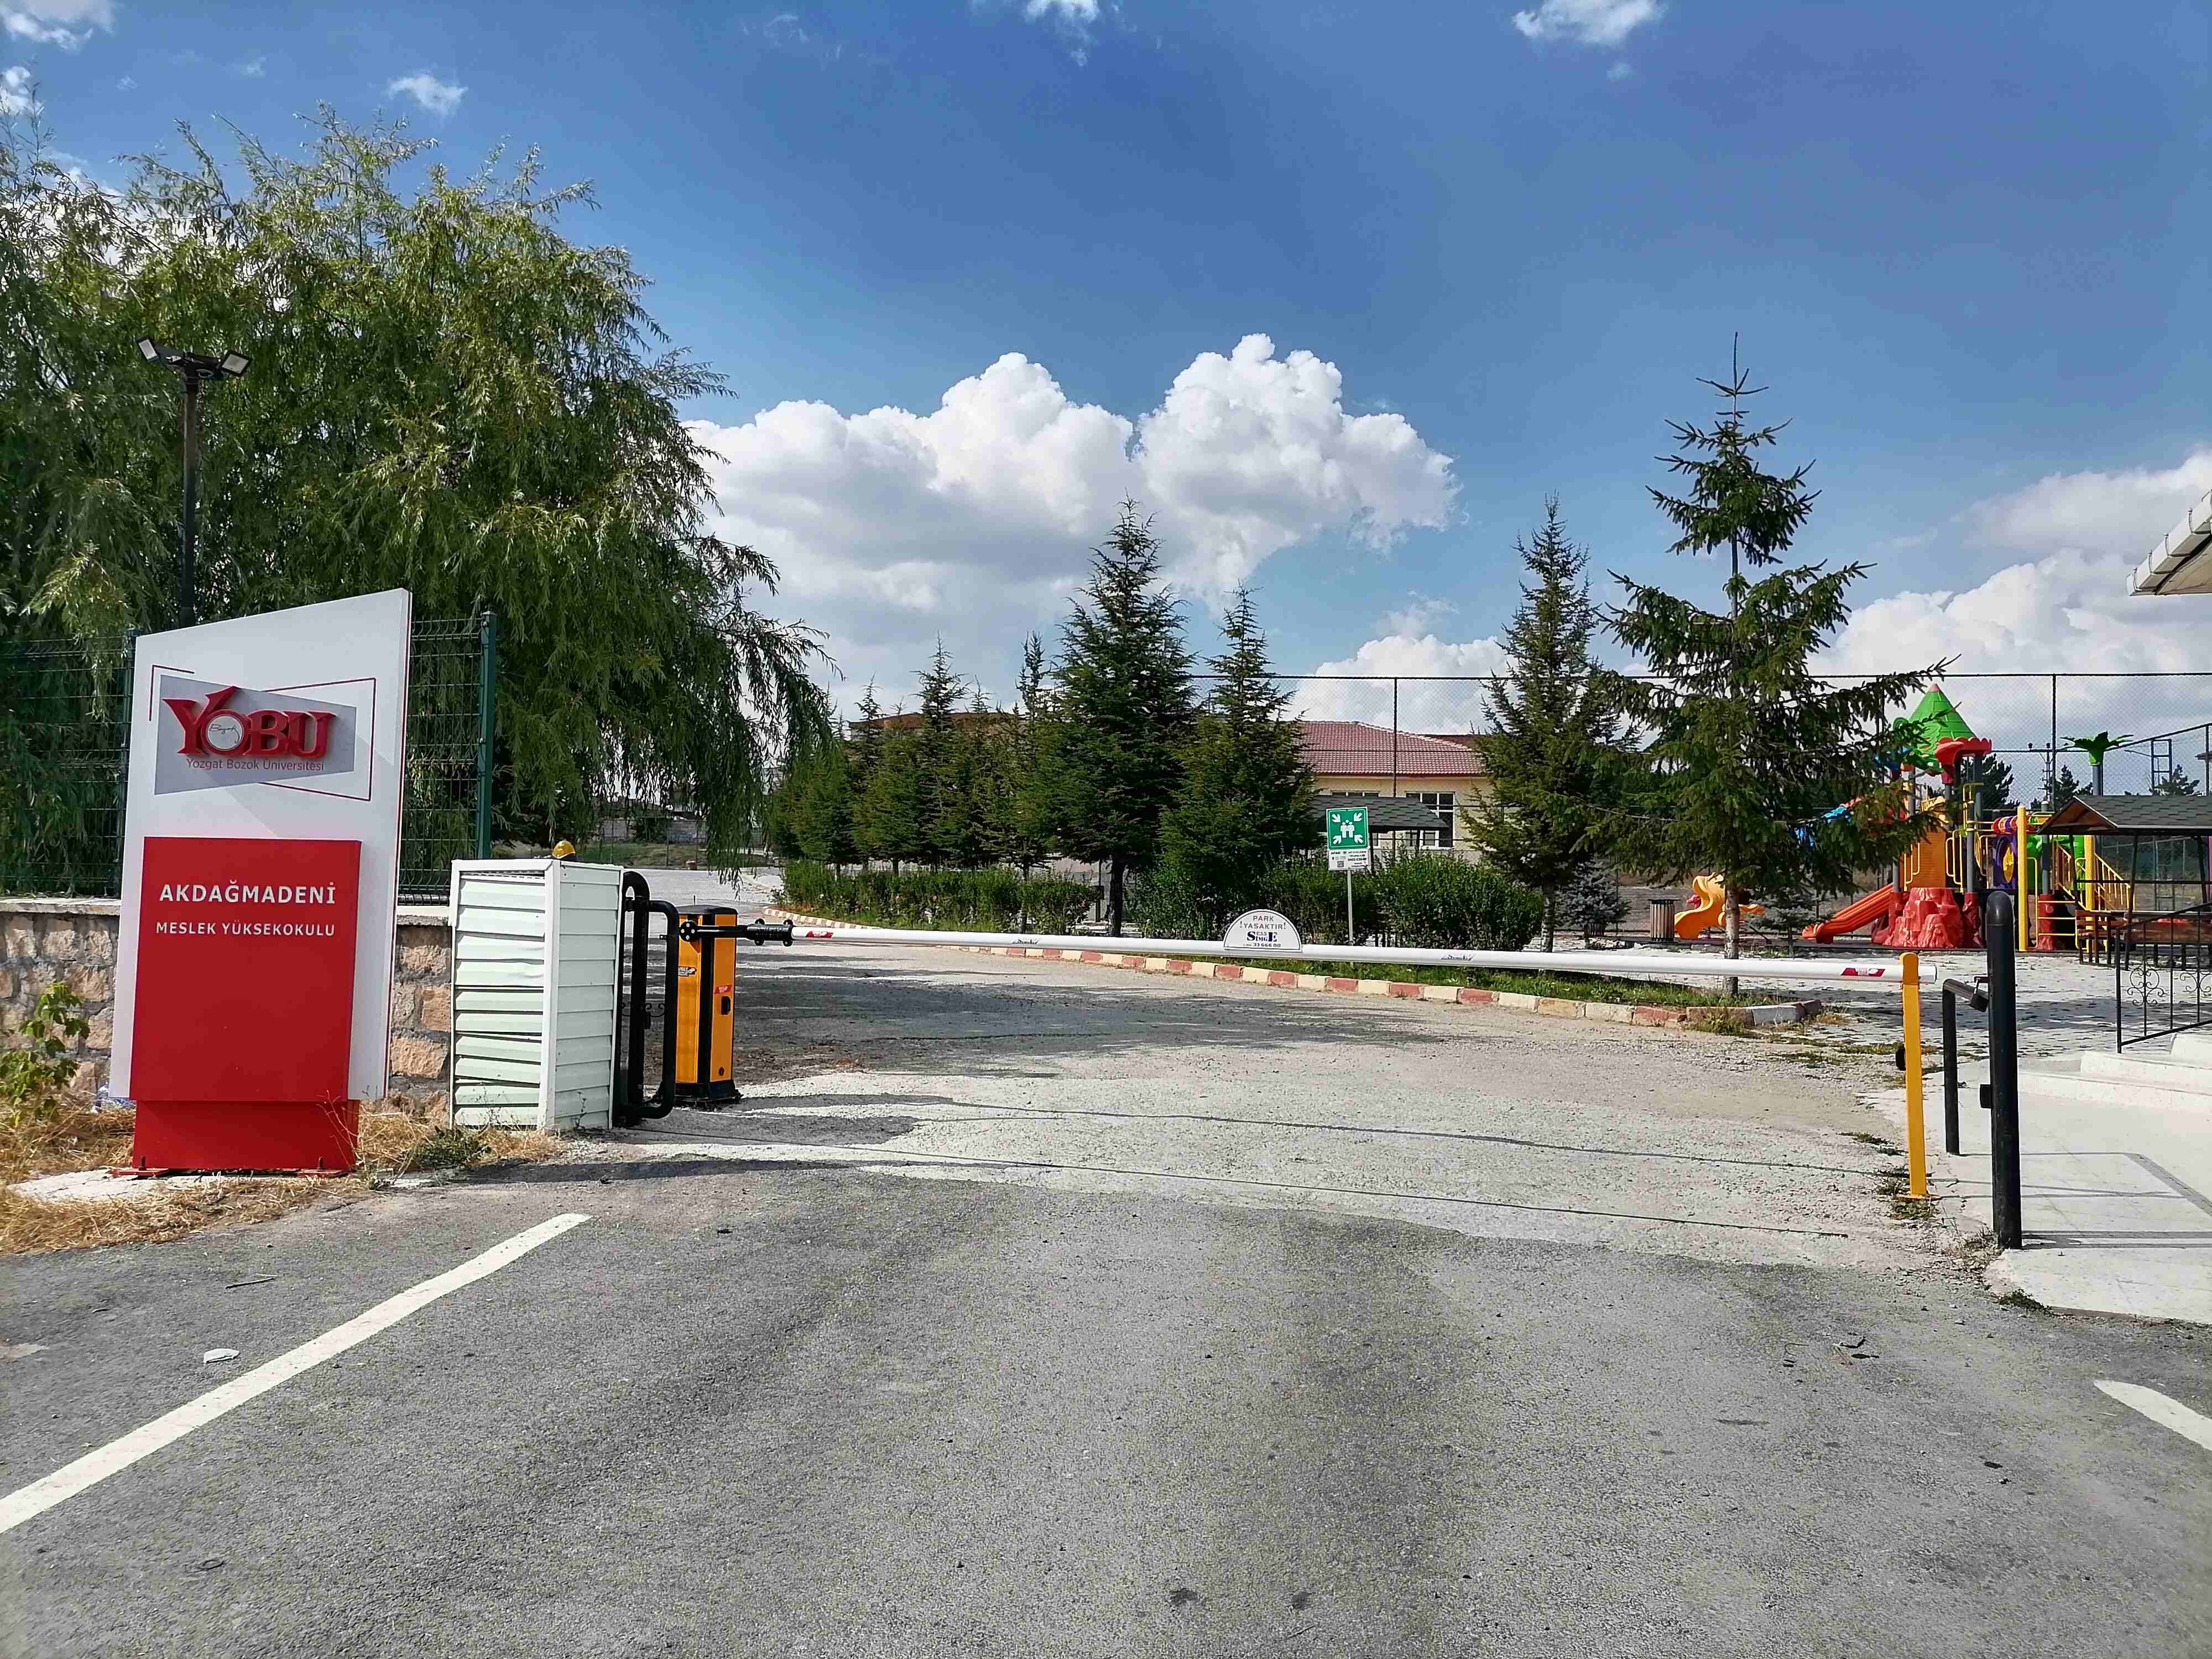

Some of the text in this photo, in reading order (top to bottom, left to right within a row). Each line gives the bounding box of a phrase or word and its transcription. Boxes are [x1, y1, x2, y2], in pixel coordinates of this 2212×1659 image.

[162, 686, 336, 758] YOBU
[186, 758, 222, 770] Yozgat
[227, 759, 259, 769] Bozok
[159, 879, 336, 904] AKDAĞMADENİ
[156, 920, 335, 936] MESLEK YÜKSEKOKULU
